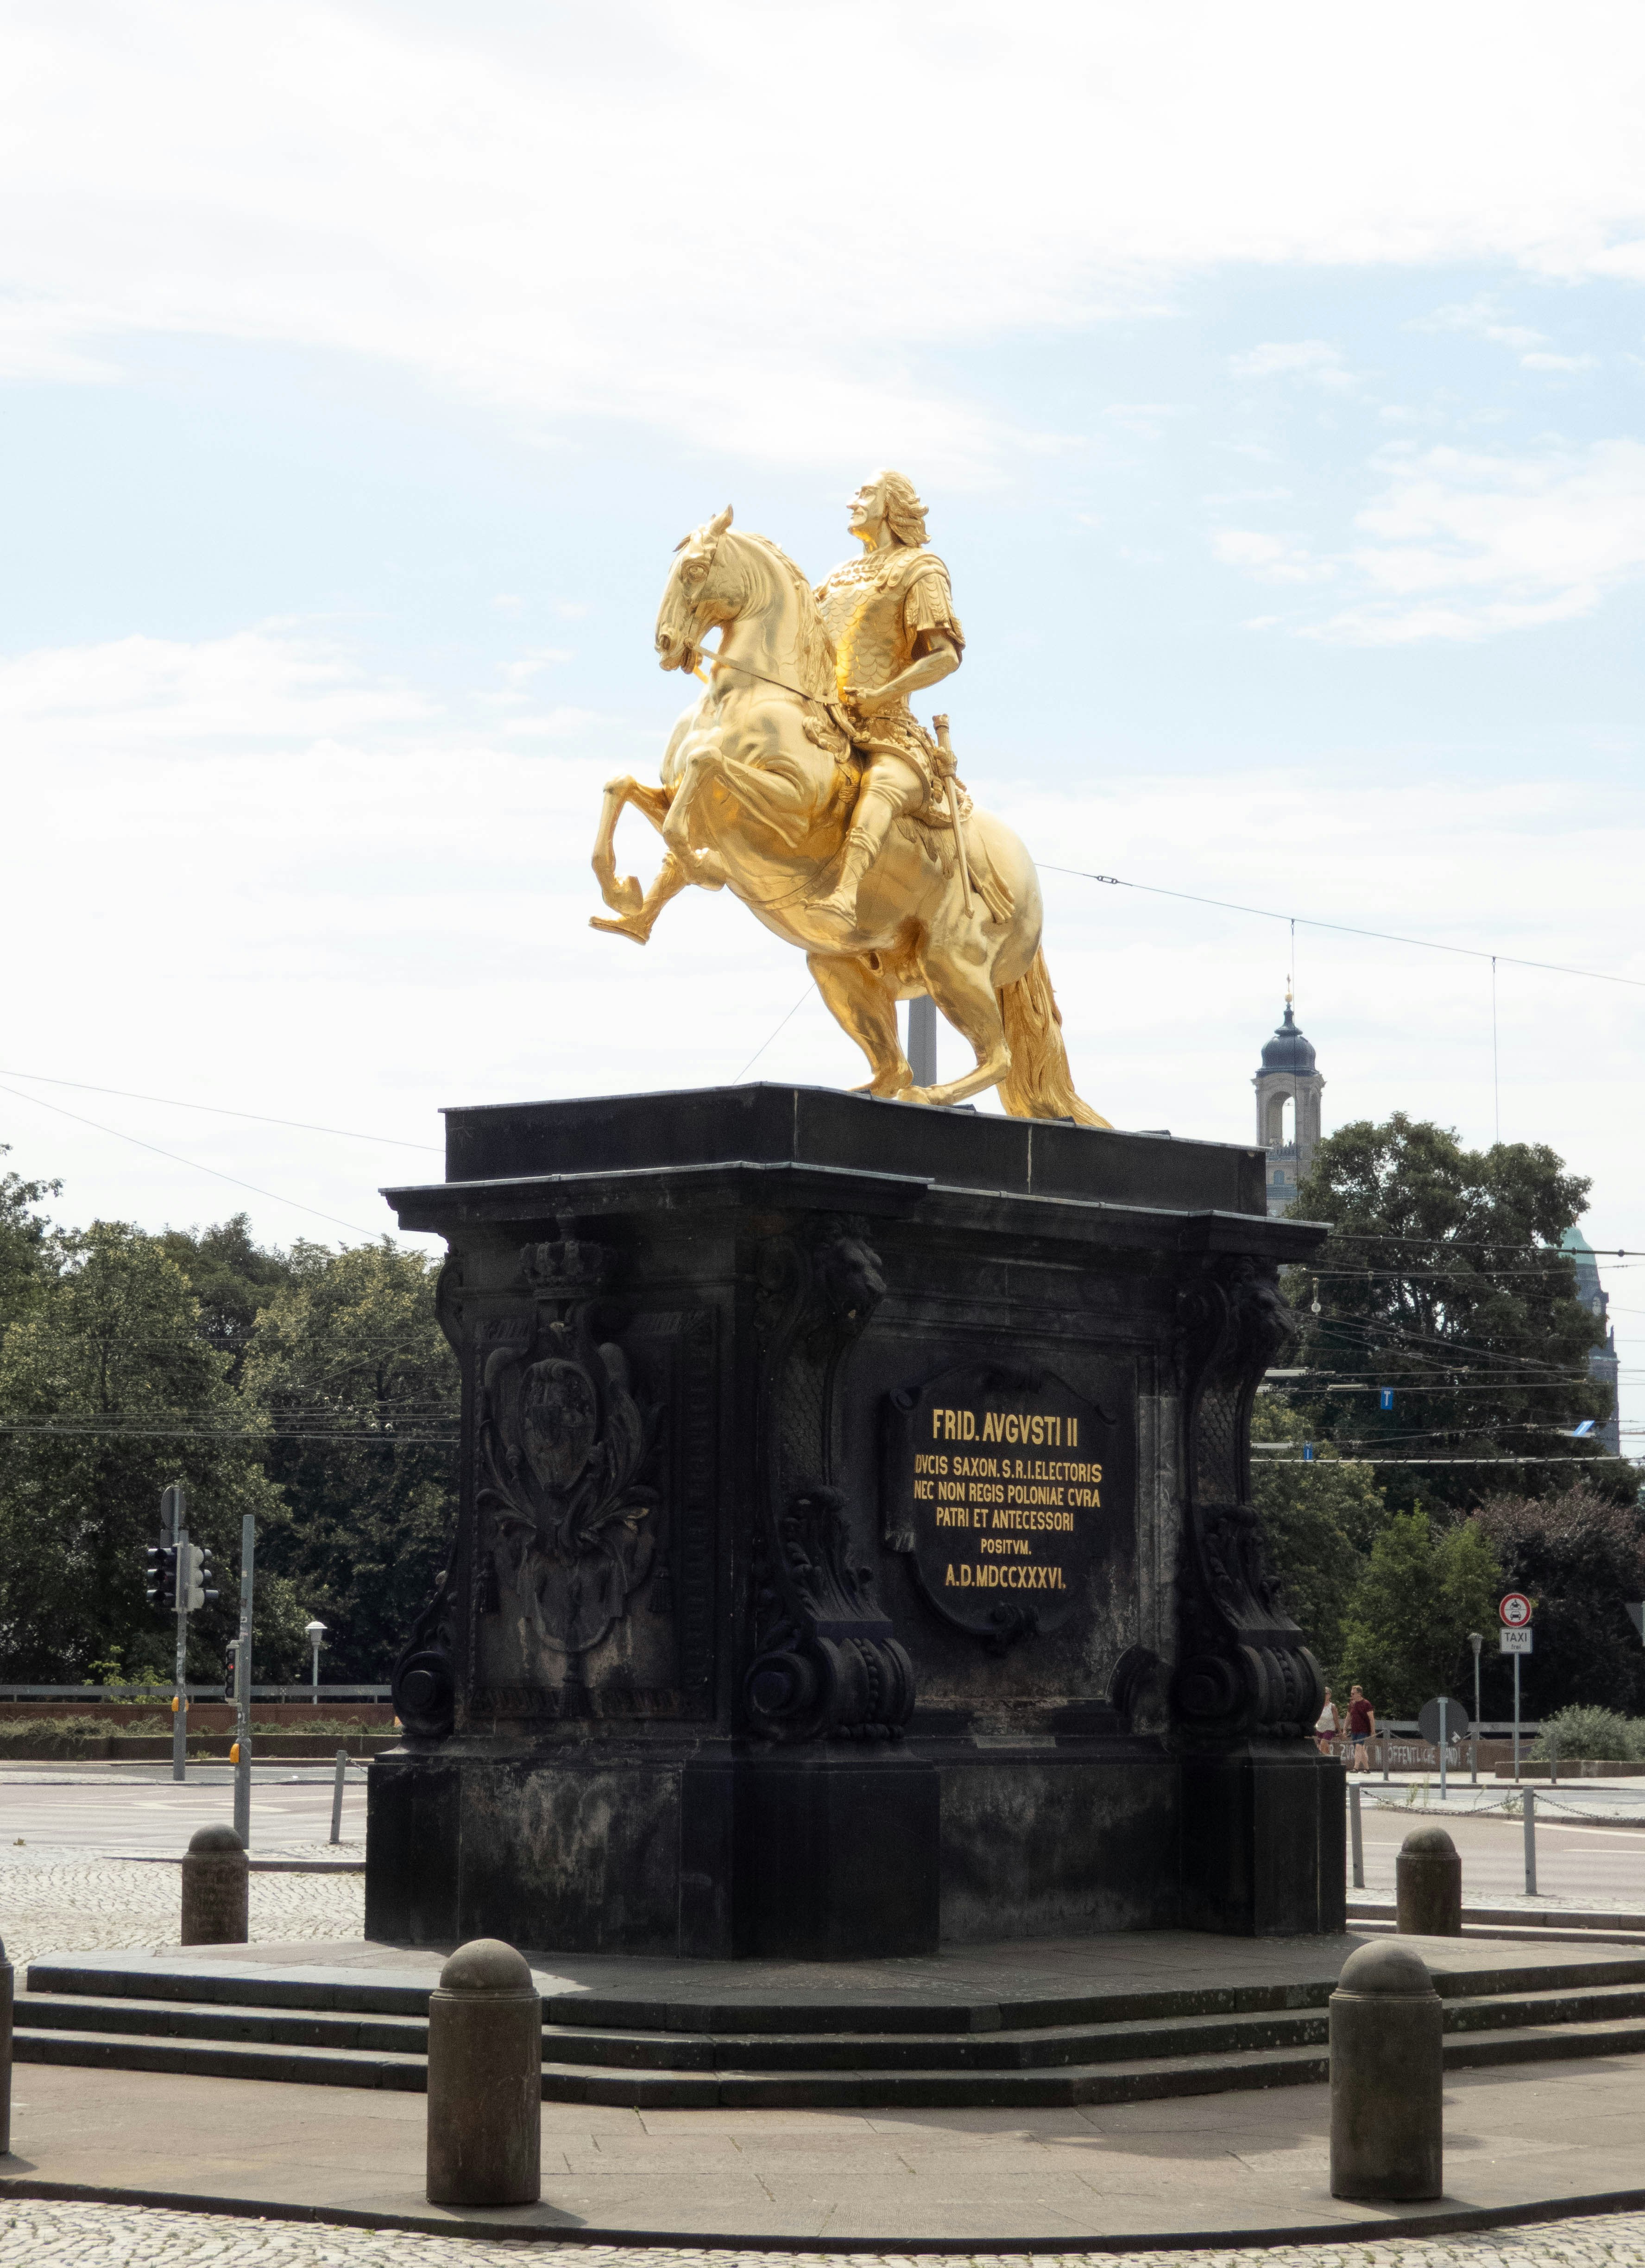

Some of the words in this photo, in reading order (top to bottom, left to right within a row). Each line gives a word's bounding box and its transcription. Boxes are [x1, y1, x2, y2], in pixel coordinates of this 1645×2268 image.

[933, 1409, 980, 1441] FRID.
[981, 1411, 1061, 1446] AVGVSTI
[1067, 1418, 1078, 1447] II
[914, 1454, 948, 1475] DVCIS
[914, 1480, 934, 1500] NEC
[938, 1481, 966, 1501] NON
[969, 1482, 1005, 1503] REGIS
[1007, 1484, 1065, 1506] POLONIAE
[1067, 1487, 1101, 1508] CVRA
[936, 1506, 969, 1527] PATRI
[973, 1508, 989, 1528] ET
[991, 1509, 1074, 1531] ANTECESSORI
[980, 1538, 1032, 1555] POSITVM.
[1504, 1632, 1527, 1642] TAXI
